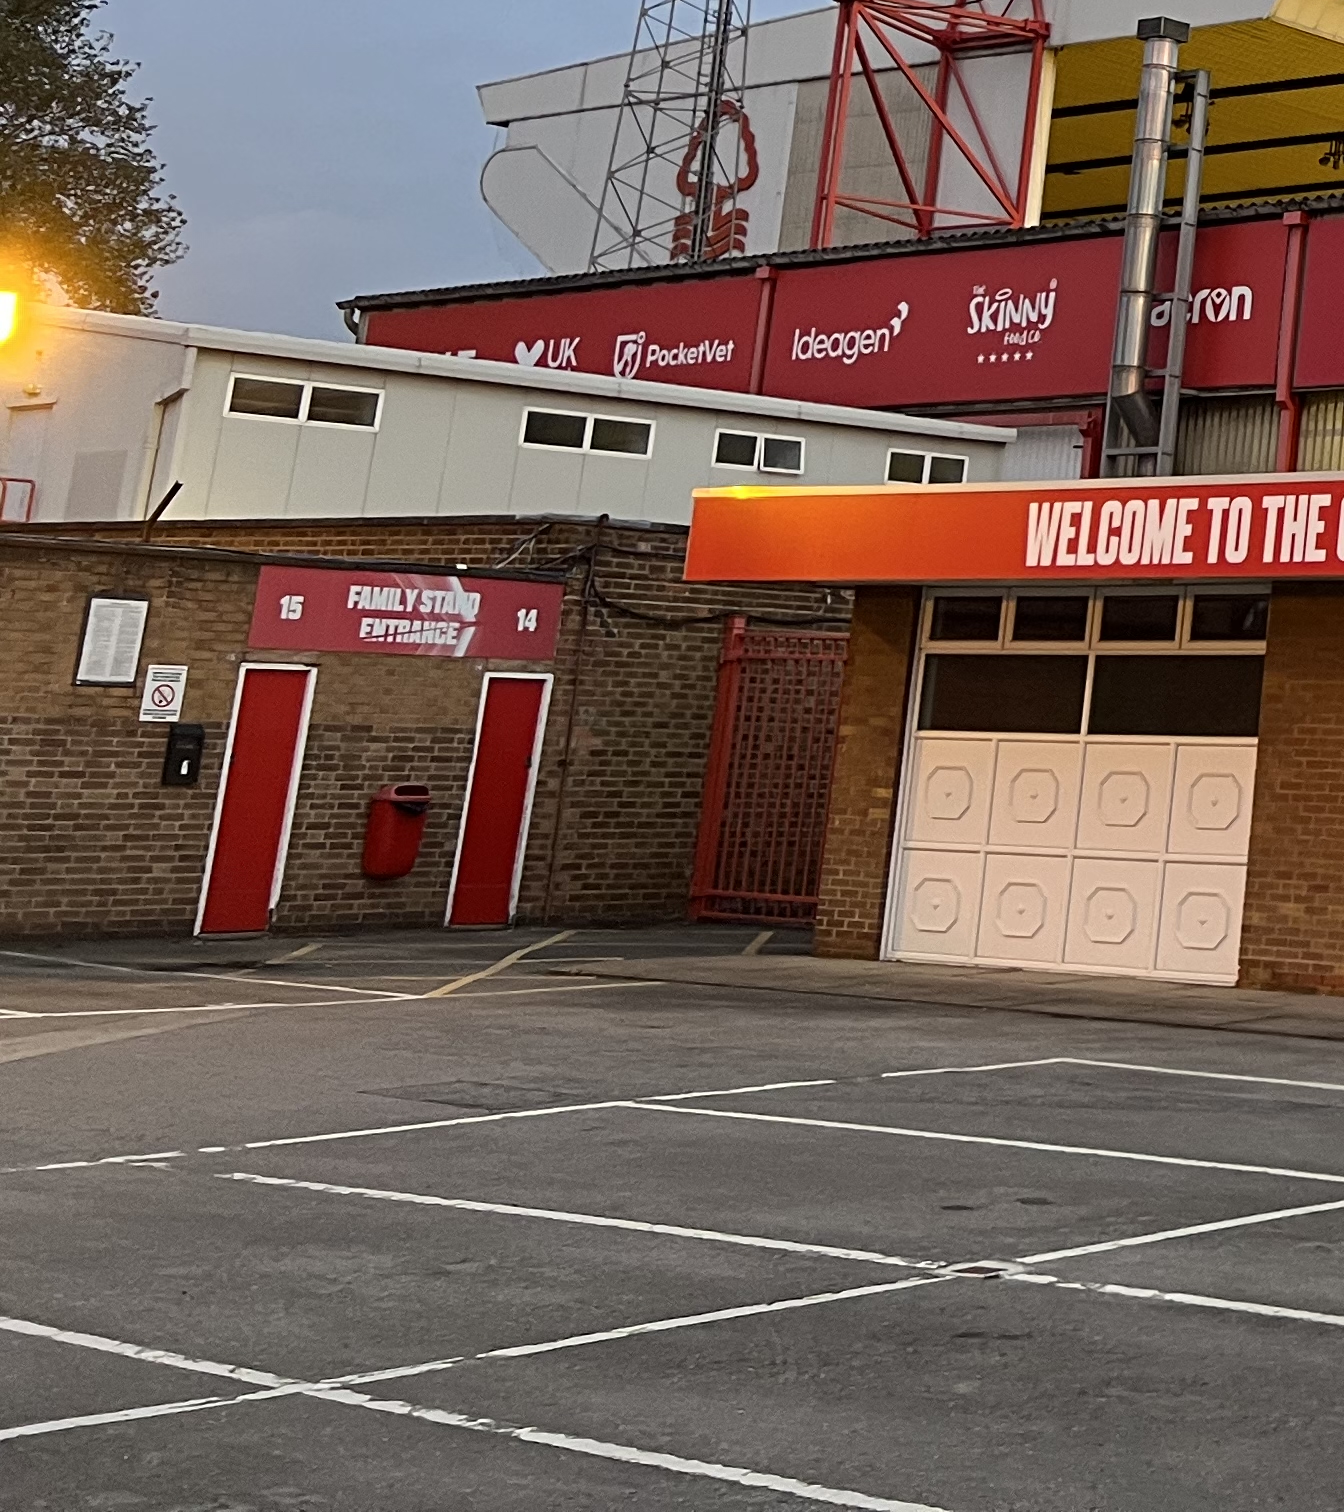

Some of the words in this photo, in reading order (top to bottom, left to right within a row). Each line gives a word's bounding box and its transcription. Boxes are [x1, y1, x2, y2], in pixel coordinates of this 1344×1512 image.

[548, 337, 580, 367] UK
[646, 340, 734, 367] PocketVet
[792, 328, 889, 364] Ideagen
[1026, 498, 1197, 566] WELCOME
[1207, 497, 1252, 563] TO
[1262, 494, 1330, 562] THE
[279, 595, 305, 620] 15
[347, 585, 419, 612] FAMILY
[420, 590, 481, 618] STAND
[359, 617, 460, 645] ENTRANCE
[517, 608, 538, 632] 14
